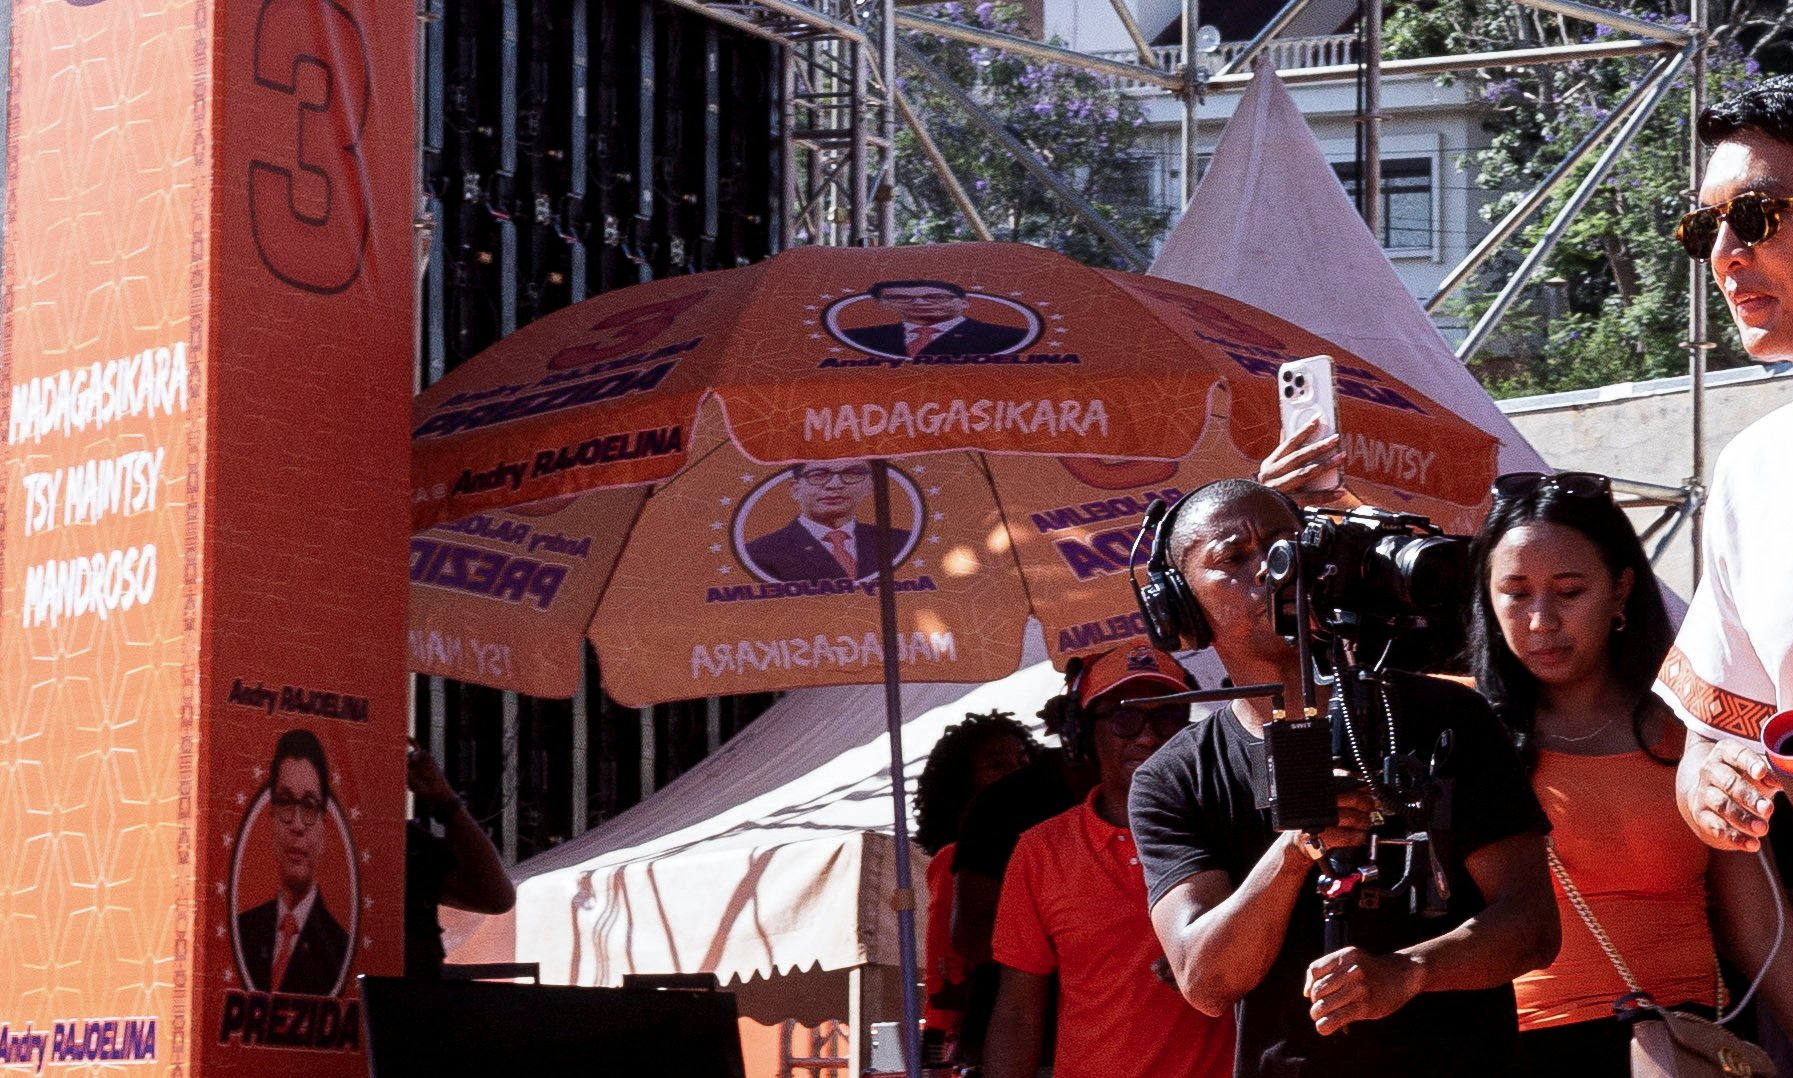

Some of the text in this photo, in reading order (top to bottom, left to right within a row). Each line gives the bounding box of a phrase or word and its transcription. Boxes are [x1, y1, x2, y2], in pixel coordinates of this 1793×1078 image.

[8, 341, 189, 445] MADAGASIKARA
[803, 398, 1110, 443] MADAGASIKARA
[22, 447, 164, 537] TSY MAINTSY
[452, 425, 682, 497] Andry RAJOELINA
[22, 544, 157, 630] MANDROSO
[51, 1019, 156, 1063] RAJOELINA
[219, 992, 361, 1051] PREZIDA
